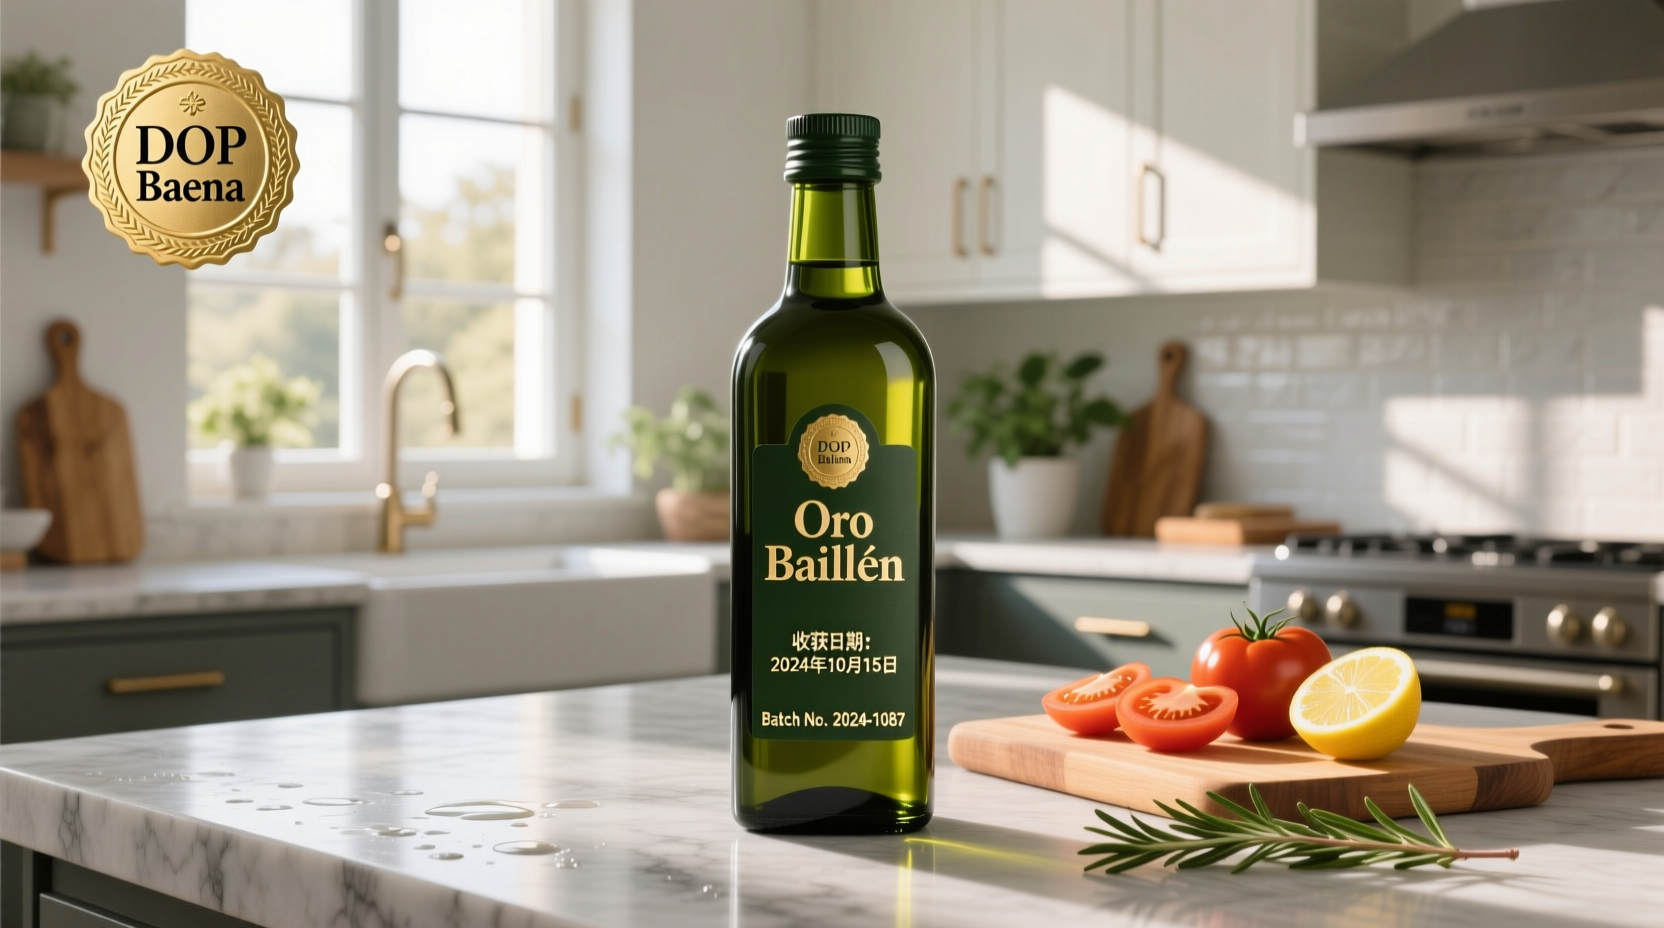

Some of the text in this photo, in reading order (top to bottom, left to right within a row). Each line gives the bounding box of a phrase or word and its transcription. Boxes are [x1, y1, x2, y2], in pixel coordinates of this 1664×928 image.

[817, 440, 852, 453] DOP
[794, 499, 874, 539] Oro
[764, 543, 906, 582] Baillén
[770, 655, 897, 675] 2024年10月15日
[761, 710, 906, 727] Batch No. 2024-1087
